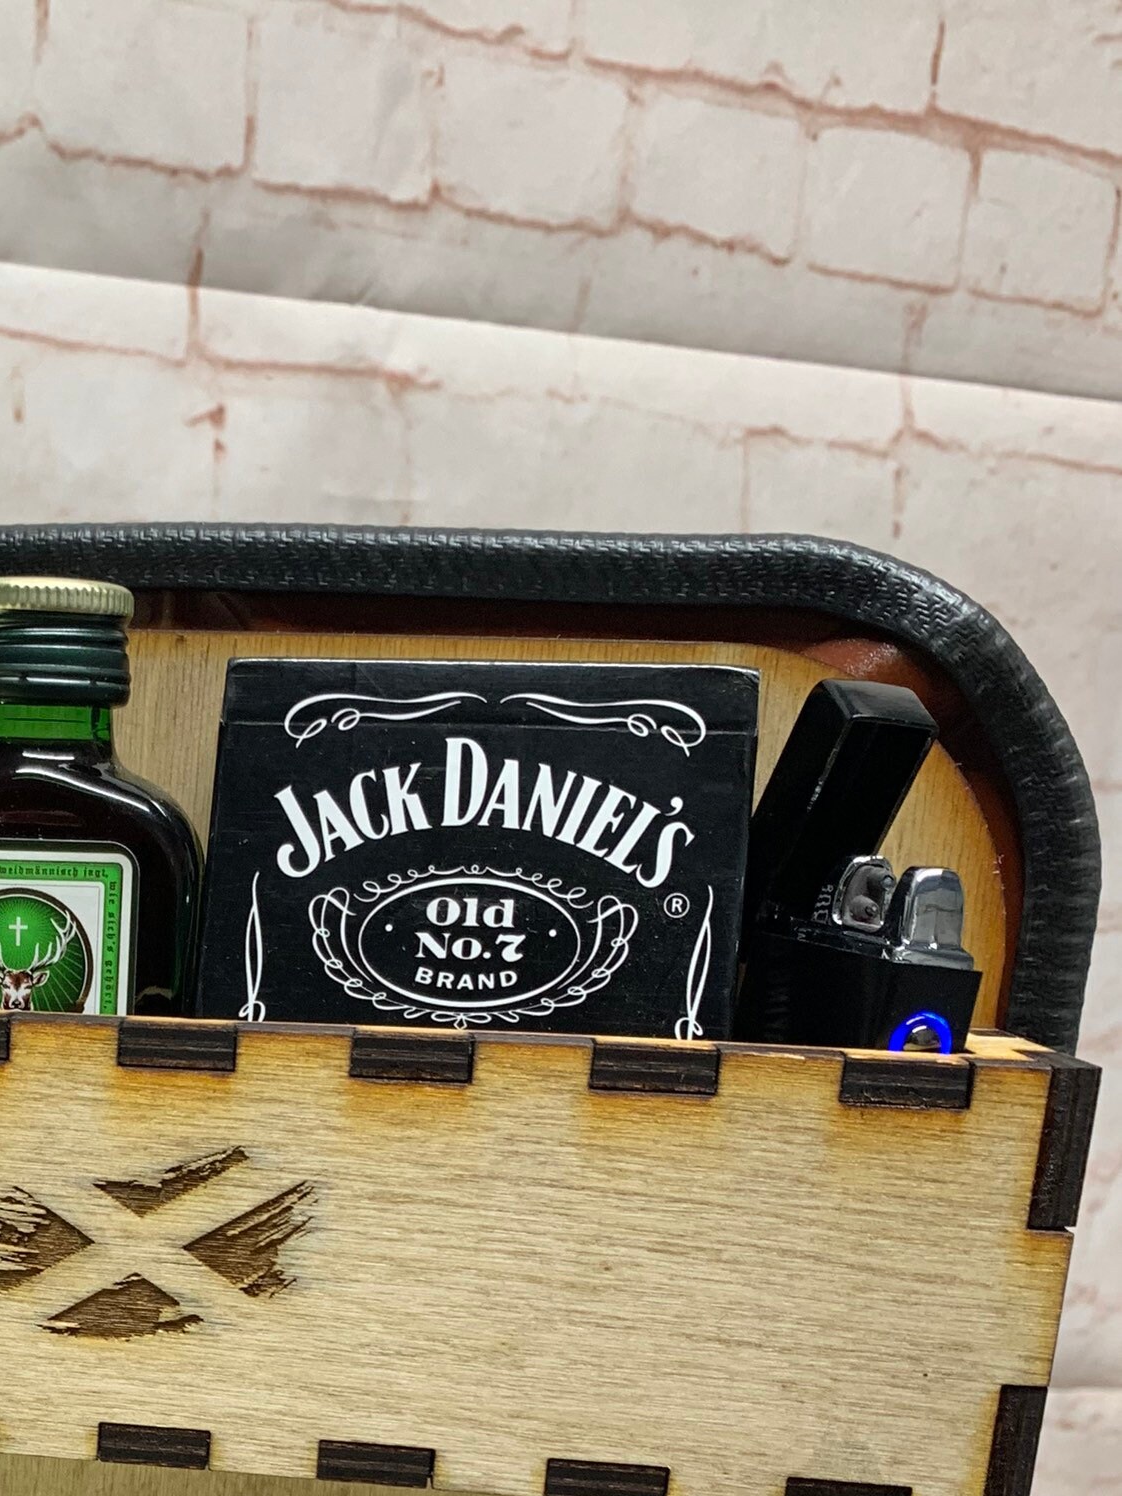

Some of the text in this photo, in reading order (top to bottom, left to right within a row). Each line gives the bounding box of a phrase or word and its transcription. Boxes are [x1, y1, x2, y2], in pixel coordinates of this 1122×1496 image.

[274, 737, 695, 888] JACK DANIEL'S
[426, 897, 515, 928] Old
[415, 931, 526, 963] No.7
[415, 968, 518, 991] BRAND
